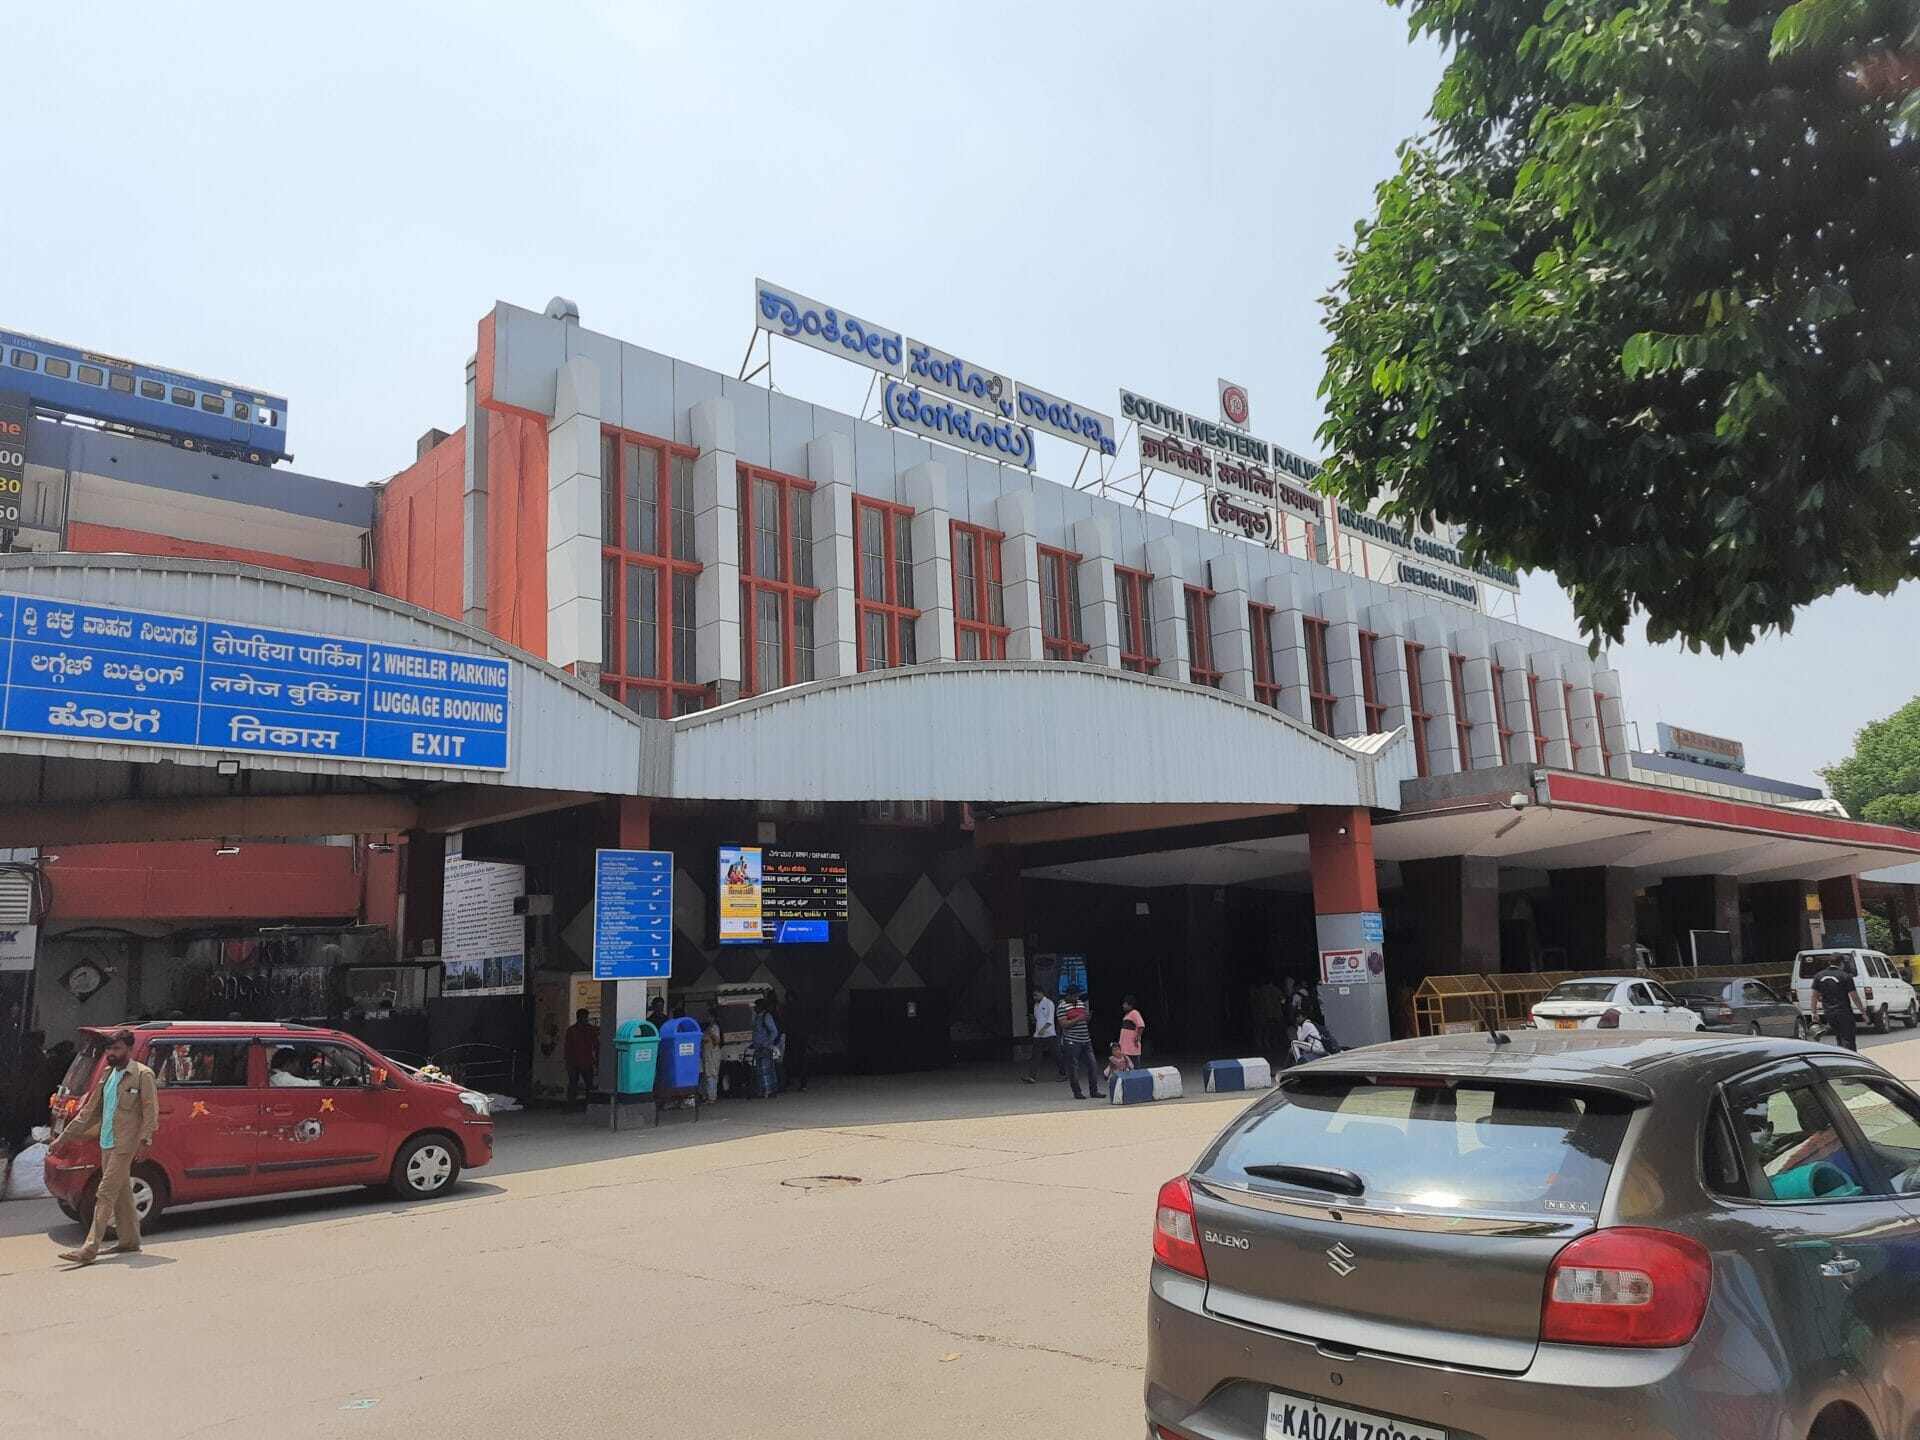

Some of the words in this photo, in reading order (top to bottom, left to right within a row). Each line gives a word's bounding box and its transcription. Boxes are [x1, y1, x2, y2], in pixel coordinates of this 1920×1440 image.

[760, 289, 902, 365] ಕ್ರಾಂತಿವೀರ
[1019, 390, 1117, 456] ರಾಯಣ್ಣ
[1123, 392, 1185, 435] SOUTH
[1188, 417, 1269, 464] WESTERN
[1274, 447, 1326, 481] RAILW
[1397, 561, 1477, 605] (BENGALURU)
[23, 607, 38, 635] ದ್ವಿ
[46, 607, 75, 639] ಚಕ್ರ
[83, 615, 132, 638] ವಾಹನ
[140, 622, 198, 647] ನಿಲುಗಡೆ
[299, 643, 363, 670] पार्किंग
[372, 651, 381, 673] 2
[384, 653, 447, 681] WHEELER
[451, 661, 506, 688] PARKING
[209, 673, 282, 698] लगेज
[287, 681, 361, 706] बुकिंग
[48, 701, 160, 734] ಹೊರಗೆ
[373, 690, 440, 718] LUGGAGE
[443, 698, 503, 724] BOOKING
[228, 714, 341, 750] निकास
[411, 732, 466, 758] EXIT
[1549, 1202, 1586, 1211] NEXA
[1205, 1230, 1250, 1250] BALENO
[1270, 1412, 1283, 1424] IND
